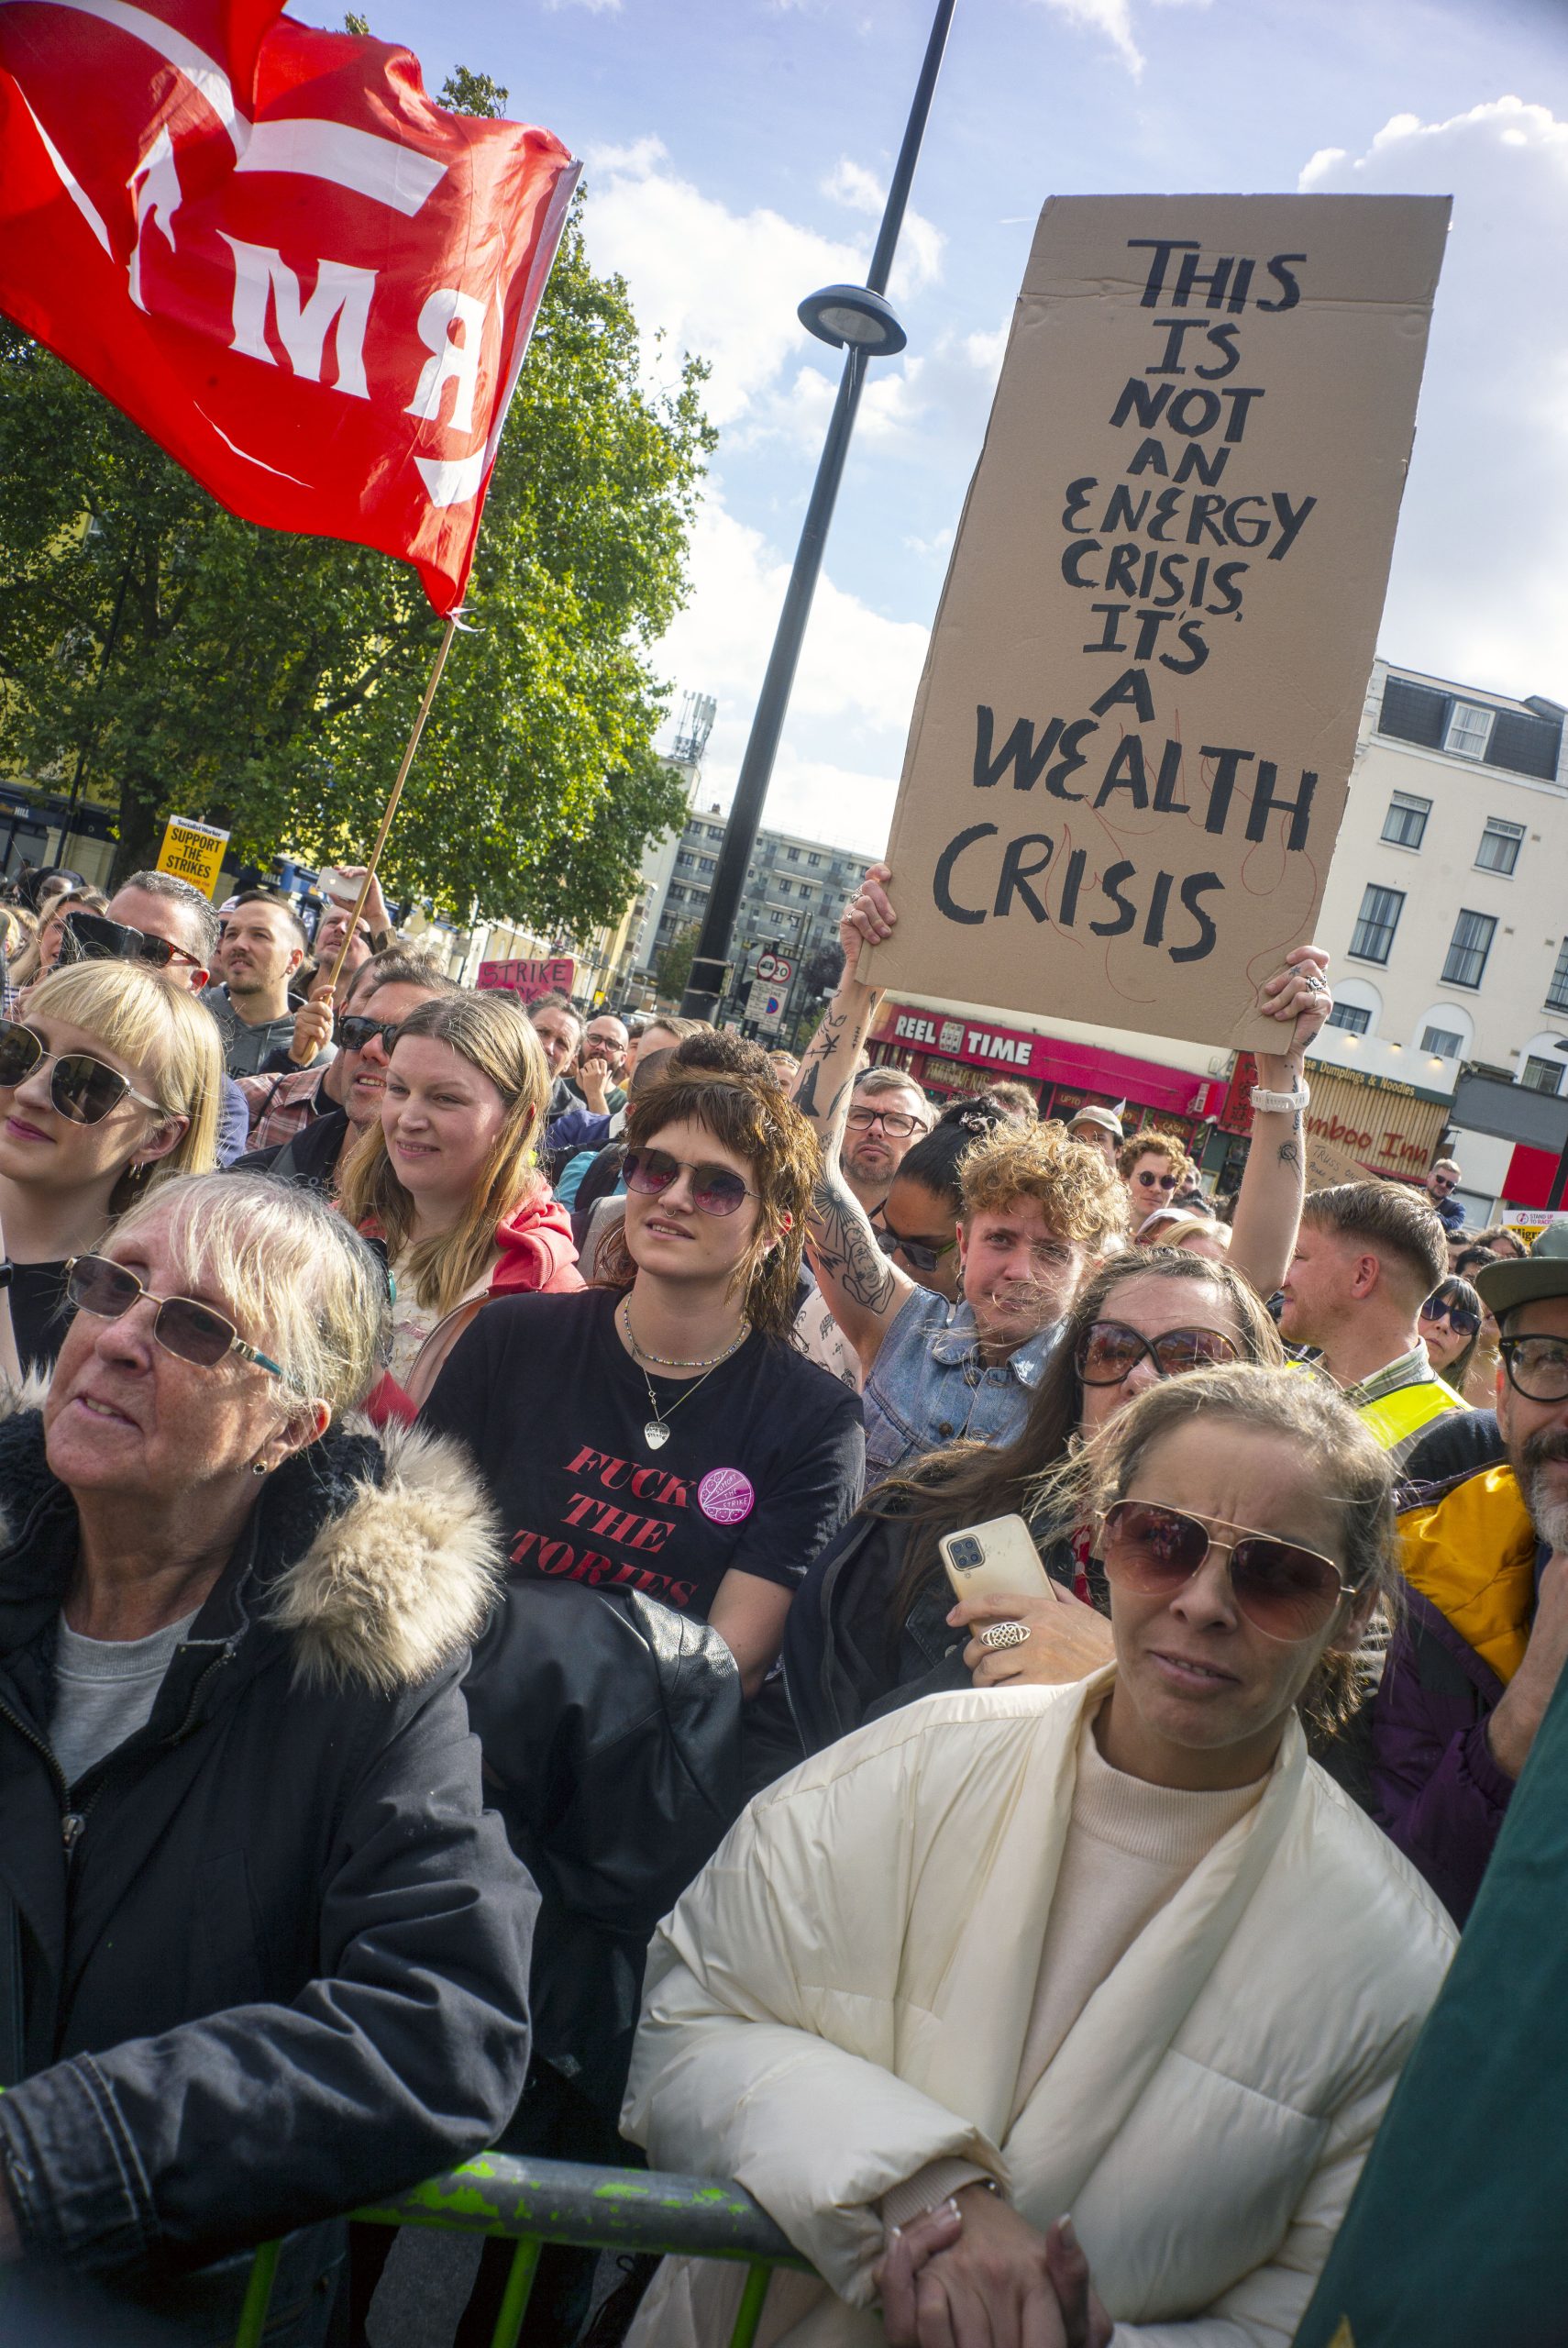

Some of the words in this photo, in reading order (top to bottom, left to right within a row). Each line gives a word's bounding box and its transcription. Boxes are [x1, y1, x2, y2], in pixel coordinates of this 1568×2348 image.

[1127, 239, 1308, 315] THIS
[1145, 319, 1241, 380] IS
[1109, 377, 1265, 443] NOT
[1126, 437, 1231, 487] AN
[1062, 477, 1318, 561] ENERGY
[1061, 538, 1251, 622] CRISIS,
[1082, 604, 1210, 675] IT'S
[1088, 669, 1155, 723] A
[973, 704, 1319, 852] WEALTH
[171, 827, 222, 853] SUPPORT
[183, 845, 204, 862] THE
[166, 855, 212, 879] STRIKES
[933, 823, 1225, 963] CRISIS
[481, 961, 567, 987] STRIKE
[895, 1014, 936, 1044] REEL
[967, 1031, 1032, 1066] TIME
[1320, 1061, 1365, 1085] Dumplings
[1368, 1074, 1376, 1086] &
[1380, 1078, 1415, 1096] Noodles
[1162, 1122, 1185, 1133] CASH
[1307, 1114, 1374, 1149] mboo
[1378, 1132, 1429, 1166] Inn
[1313, 1145, 1342, 1171] TRUSS
[563, 1444, 698, 1508] FUCK
[716, 1473, 736, 1495] SUPPORT
[723, 1488, 737, 1499] THE
[560, 1492, 677, 1553] THE
[723, 1497, 747, 1509] STRIKE
[510, 1529, 699, 1609] TORIES
